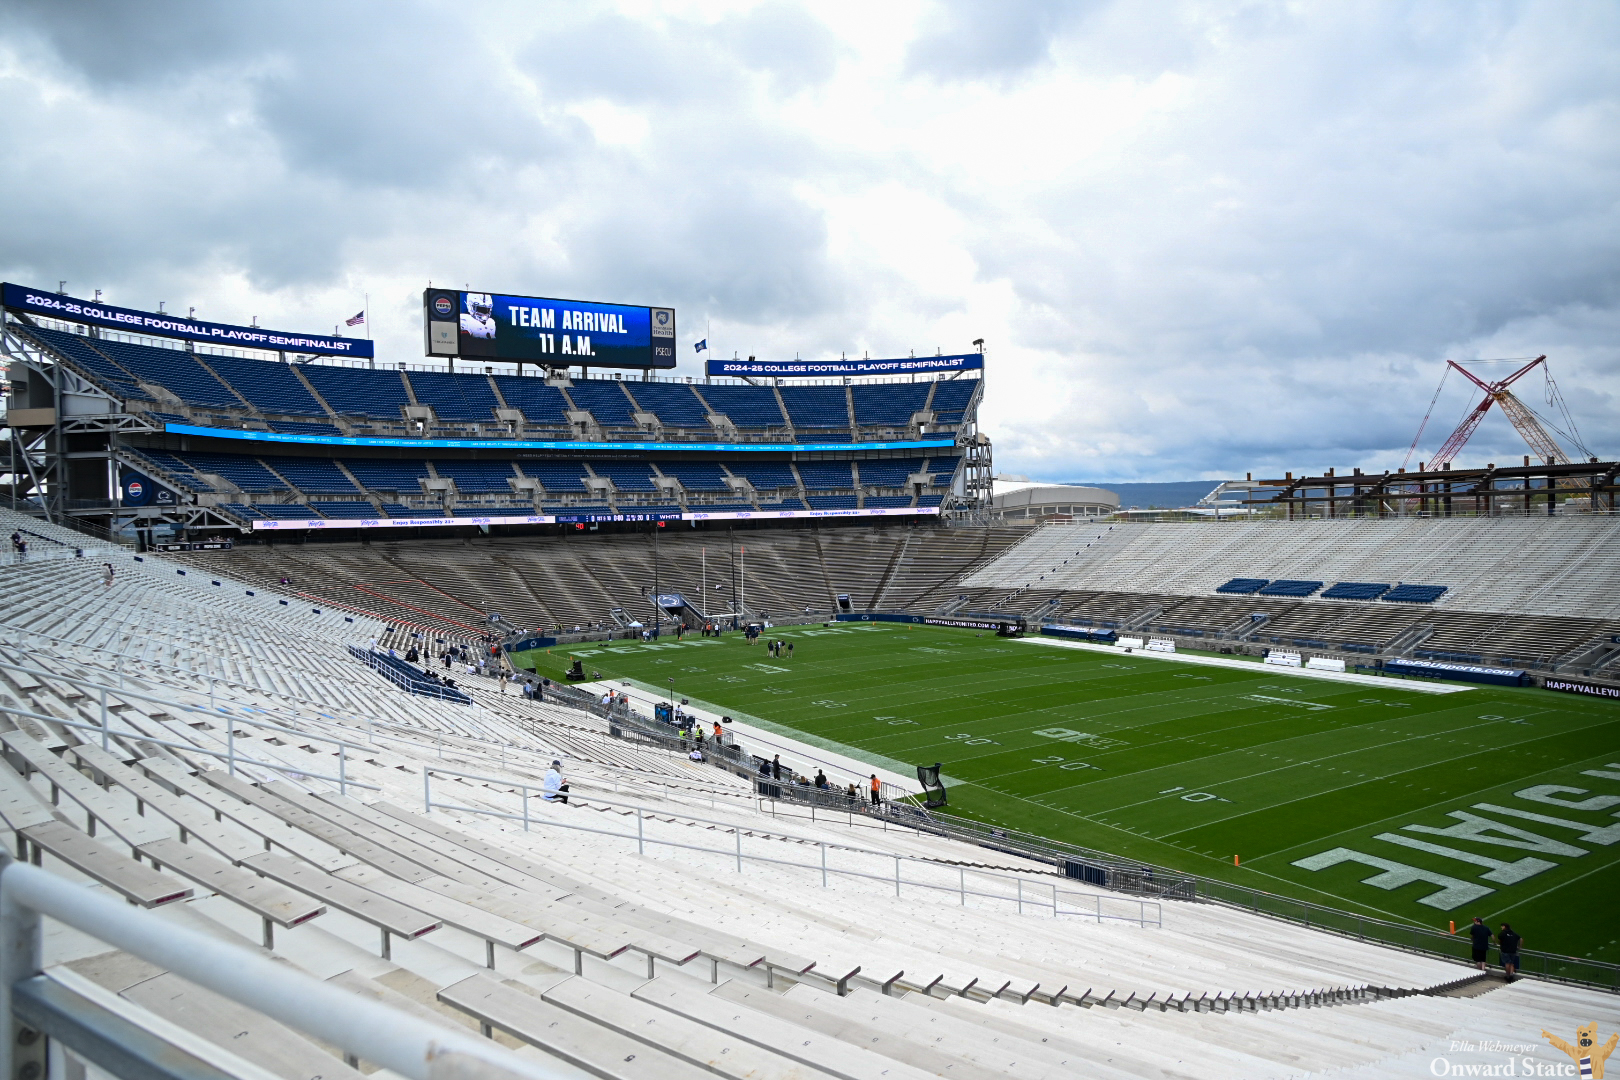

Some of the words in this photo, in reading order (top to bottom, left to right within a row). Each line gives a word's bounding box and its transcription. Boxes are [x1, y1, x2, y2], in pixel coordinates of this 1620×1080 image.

[26, 294, 82, 314] 2024-25
[83, 308, 142, 326] COLLEGE
[144, 318, 211, 336] FOOTBALL
[211, 328, 267, 343] PLAYOFF
[268, 335, 352, 350] SEMIFINALIST
[508, 305, 555, 329] TEAM
[562, 309, 628, 334] ARRIVAL
[539, 332, 555, 354] 11
[561, 334, 596, 356] A.M.
[655, 347, 672, 357] PSECU
[724, 364, 763, 372] 2024-25
[807, 364, 856, 372] FOOTBALL
[857, 363, 899, 371] PLAYOFF
[900, 359, 965, 369] SEMIFINALIST
[567, 639, 727, 657] PENN
[1396, 659, 1514, 675] GoPSUsports.com
